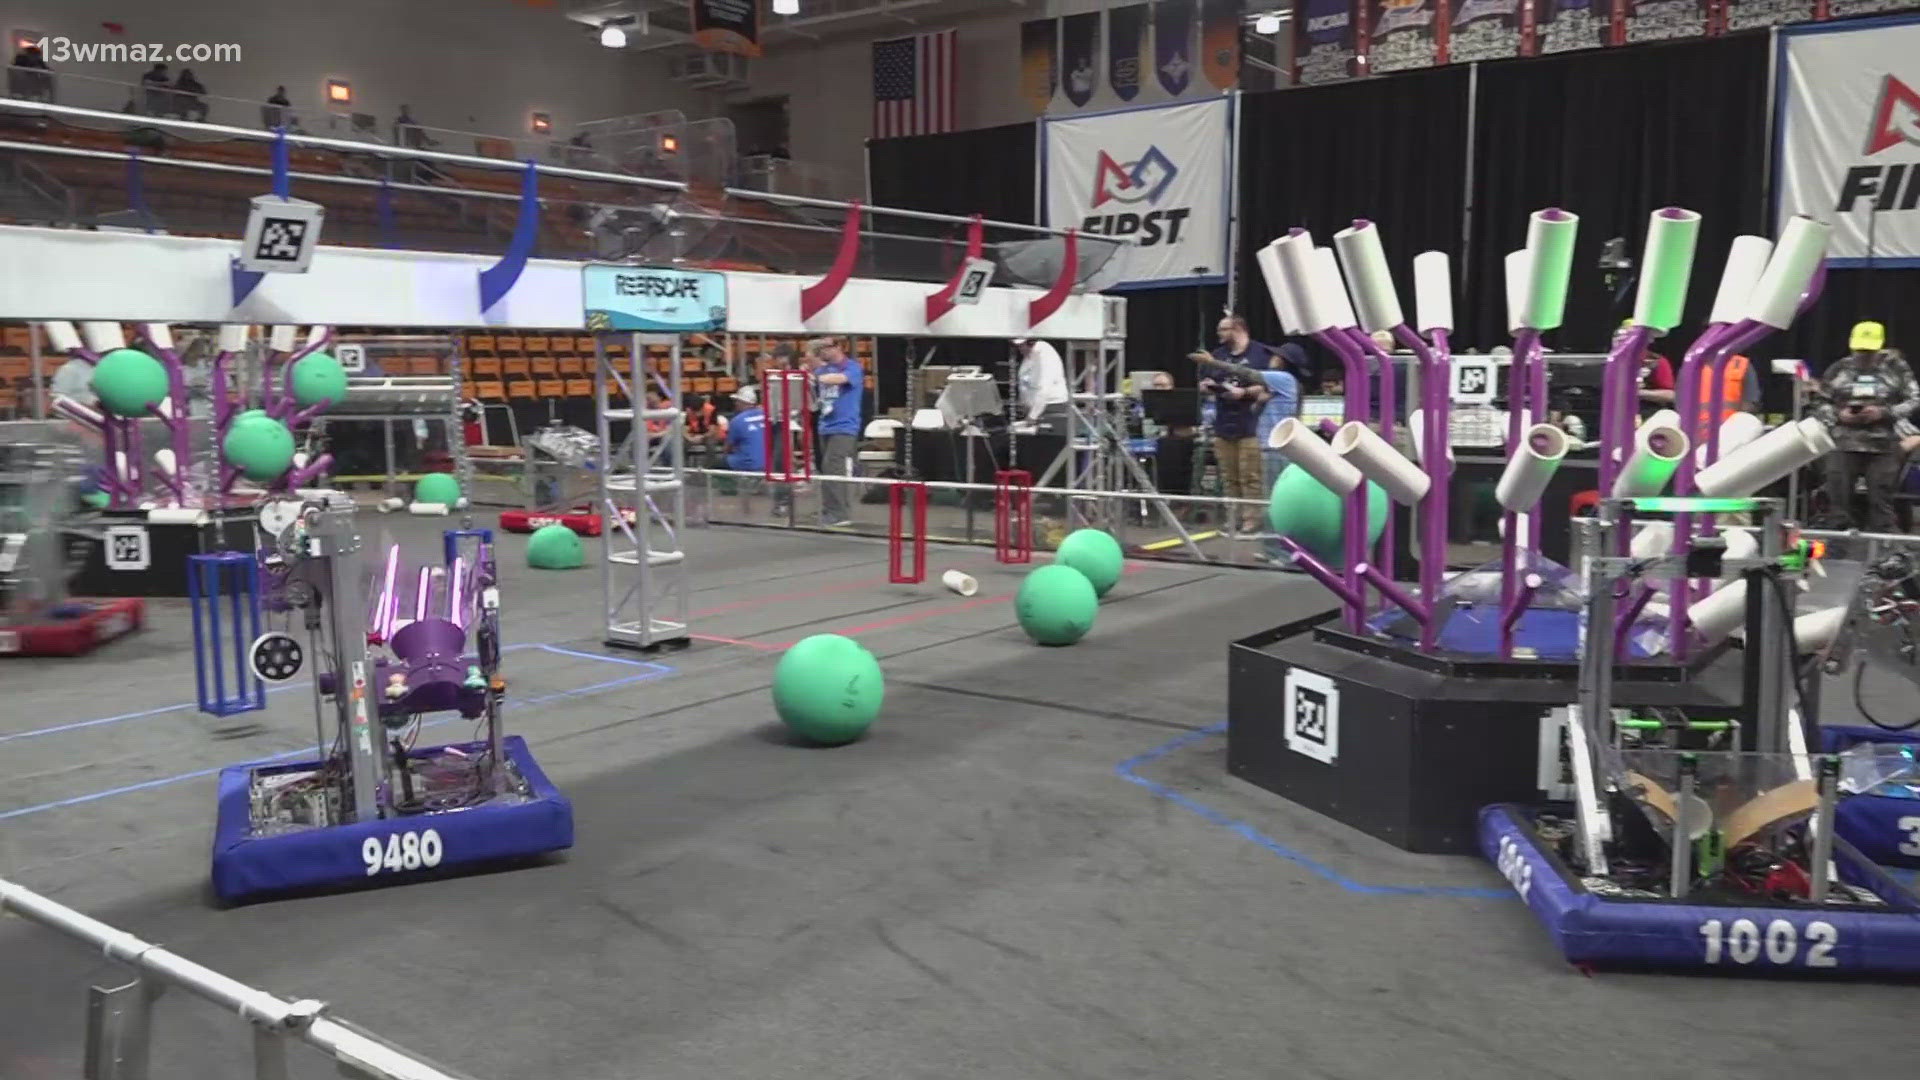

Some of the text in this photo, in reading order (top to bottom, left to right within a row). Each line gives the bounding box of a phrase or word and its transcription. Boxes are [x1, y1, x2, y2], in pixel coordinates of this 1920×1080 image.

[615, 274, 699, 301] REEFSCAPE
[362, 829, 442, 877] 9480
[1699, 918, 1838, 967] 1002
